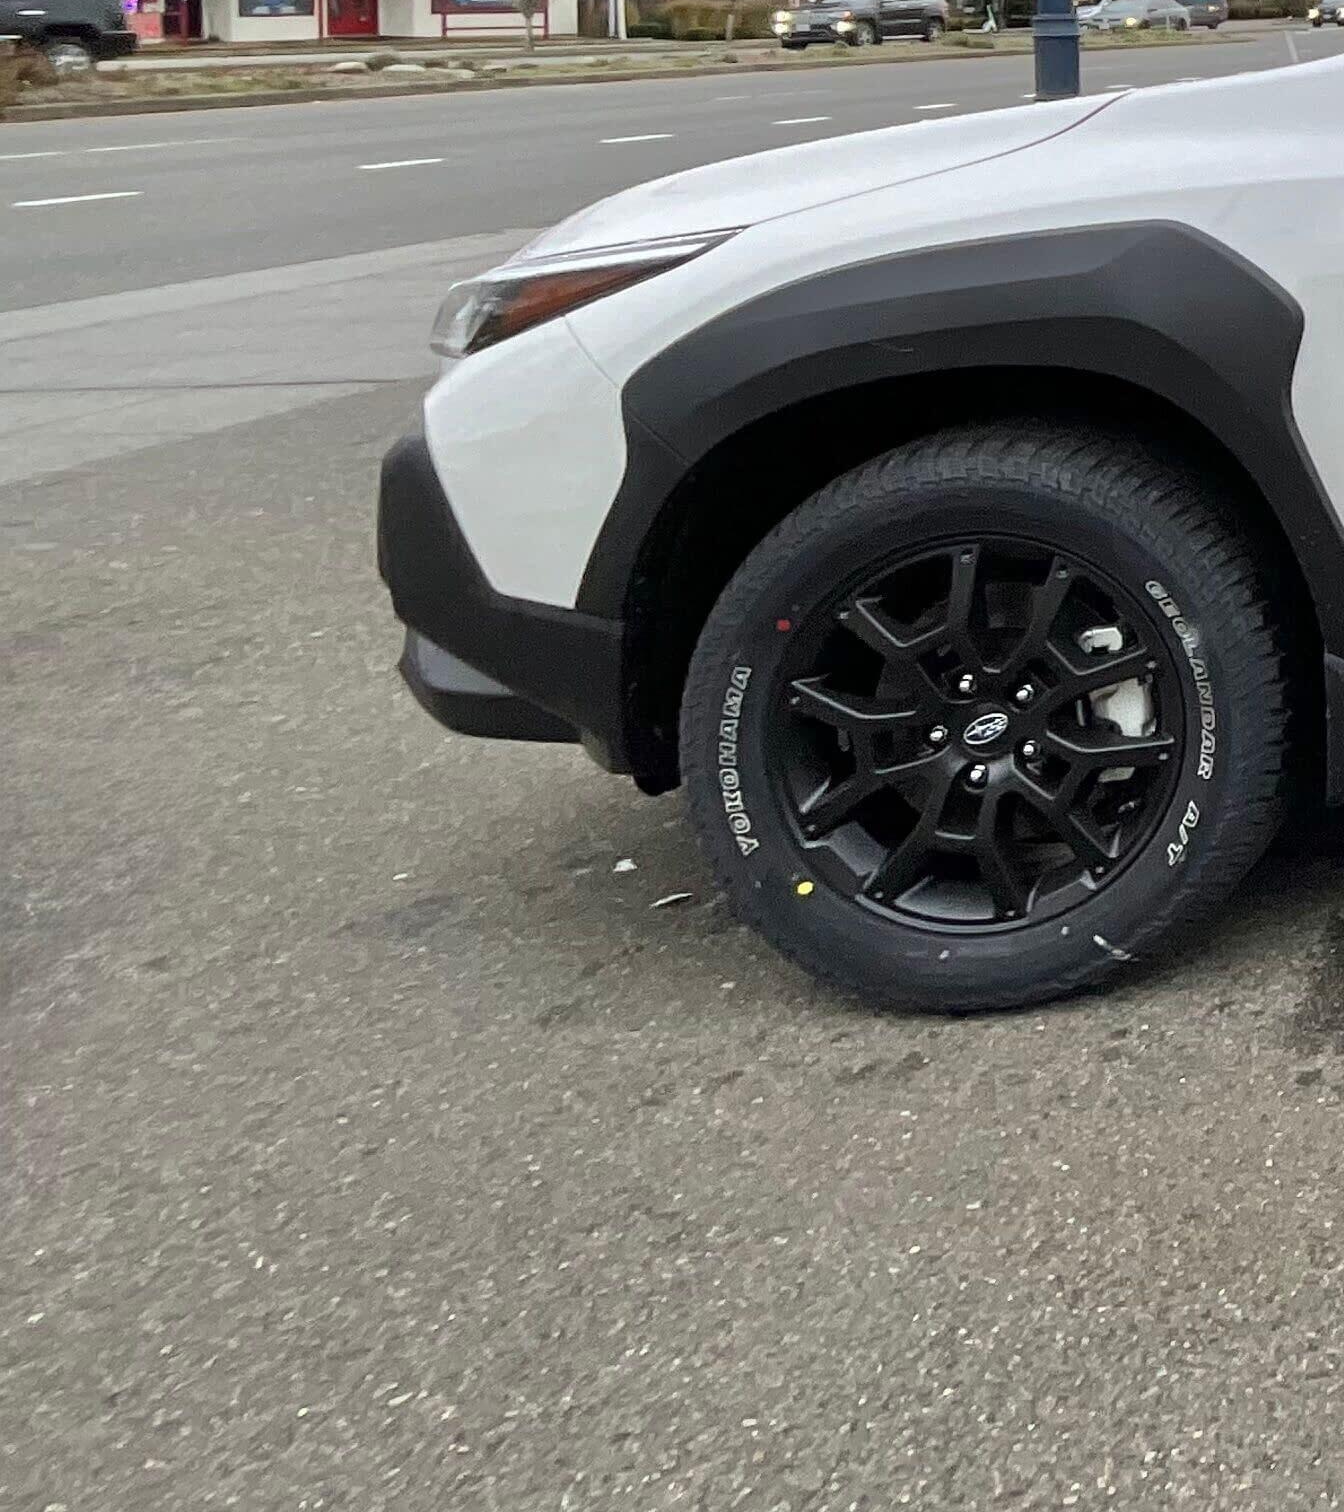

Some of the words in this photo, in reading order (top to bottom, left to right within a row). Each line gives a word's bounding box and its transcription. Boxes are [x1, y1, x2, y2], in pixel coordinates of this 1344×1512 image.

[717, 665, 760, 857] YOKOHAMA
[1145, 580, 1217, 780] GEOLANDAR
[1167, 800, 1201, 867] A/T
